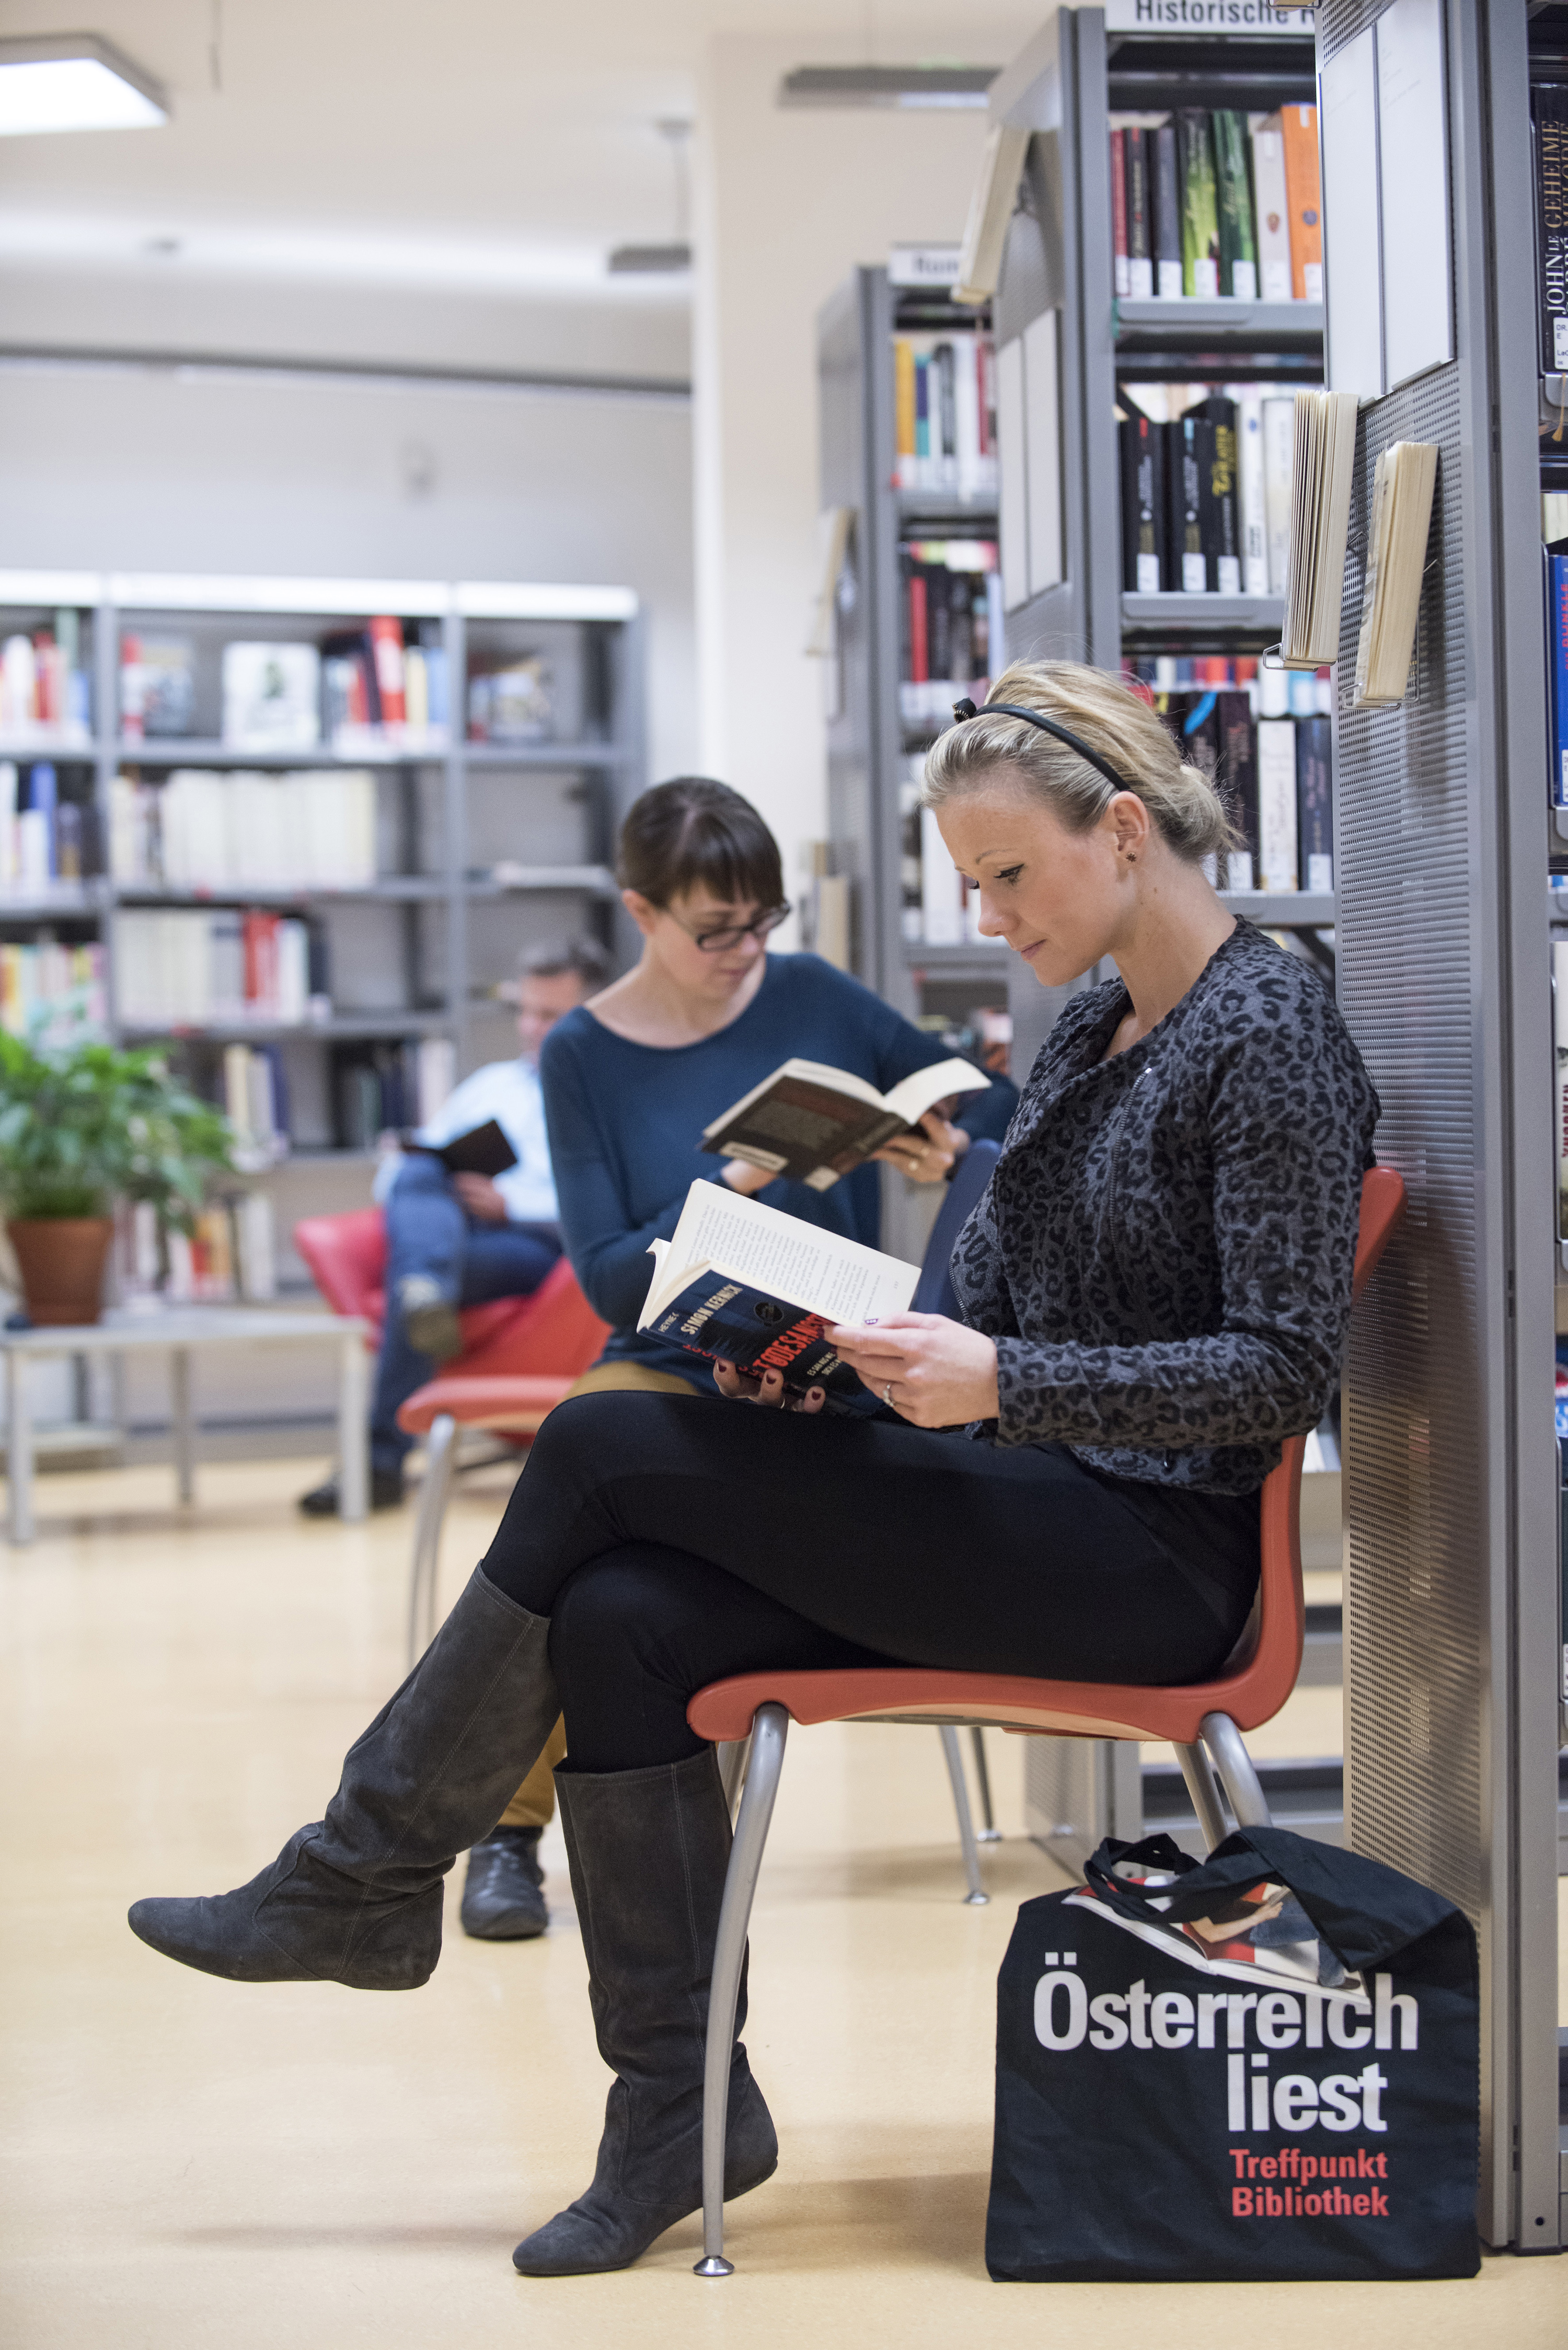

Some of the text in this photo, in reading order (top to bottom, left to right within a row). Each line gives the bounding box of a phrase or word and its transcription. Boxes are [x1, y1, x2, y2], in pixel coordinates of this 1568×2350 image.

[1541, 121, 1563, 228] GEHEIME
[1548, 236, 1560, 251] LE
[1545, 253, 1567, 315] JOHN
[681, 1284, 743, 1334] SIMON KERNICK
[1033, 1952, 1419, 2051] Österreich
[1227, 2053, 1388, 2132] liest
[1229, 2148, 1388, 2186] Treffpunkt
[1232, 2186, 1389, 2217] Bibliothek
